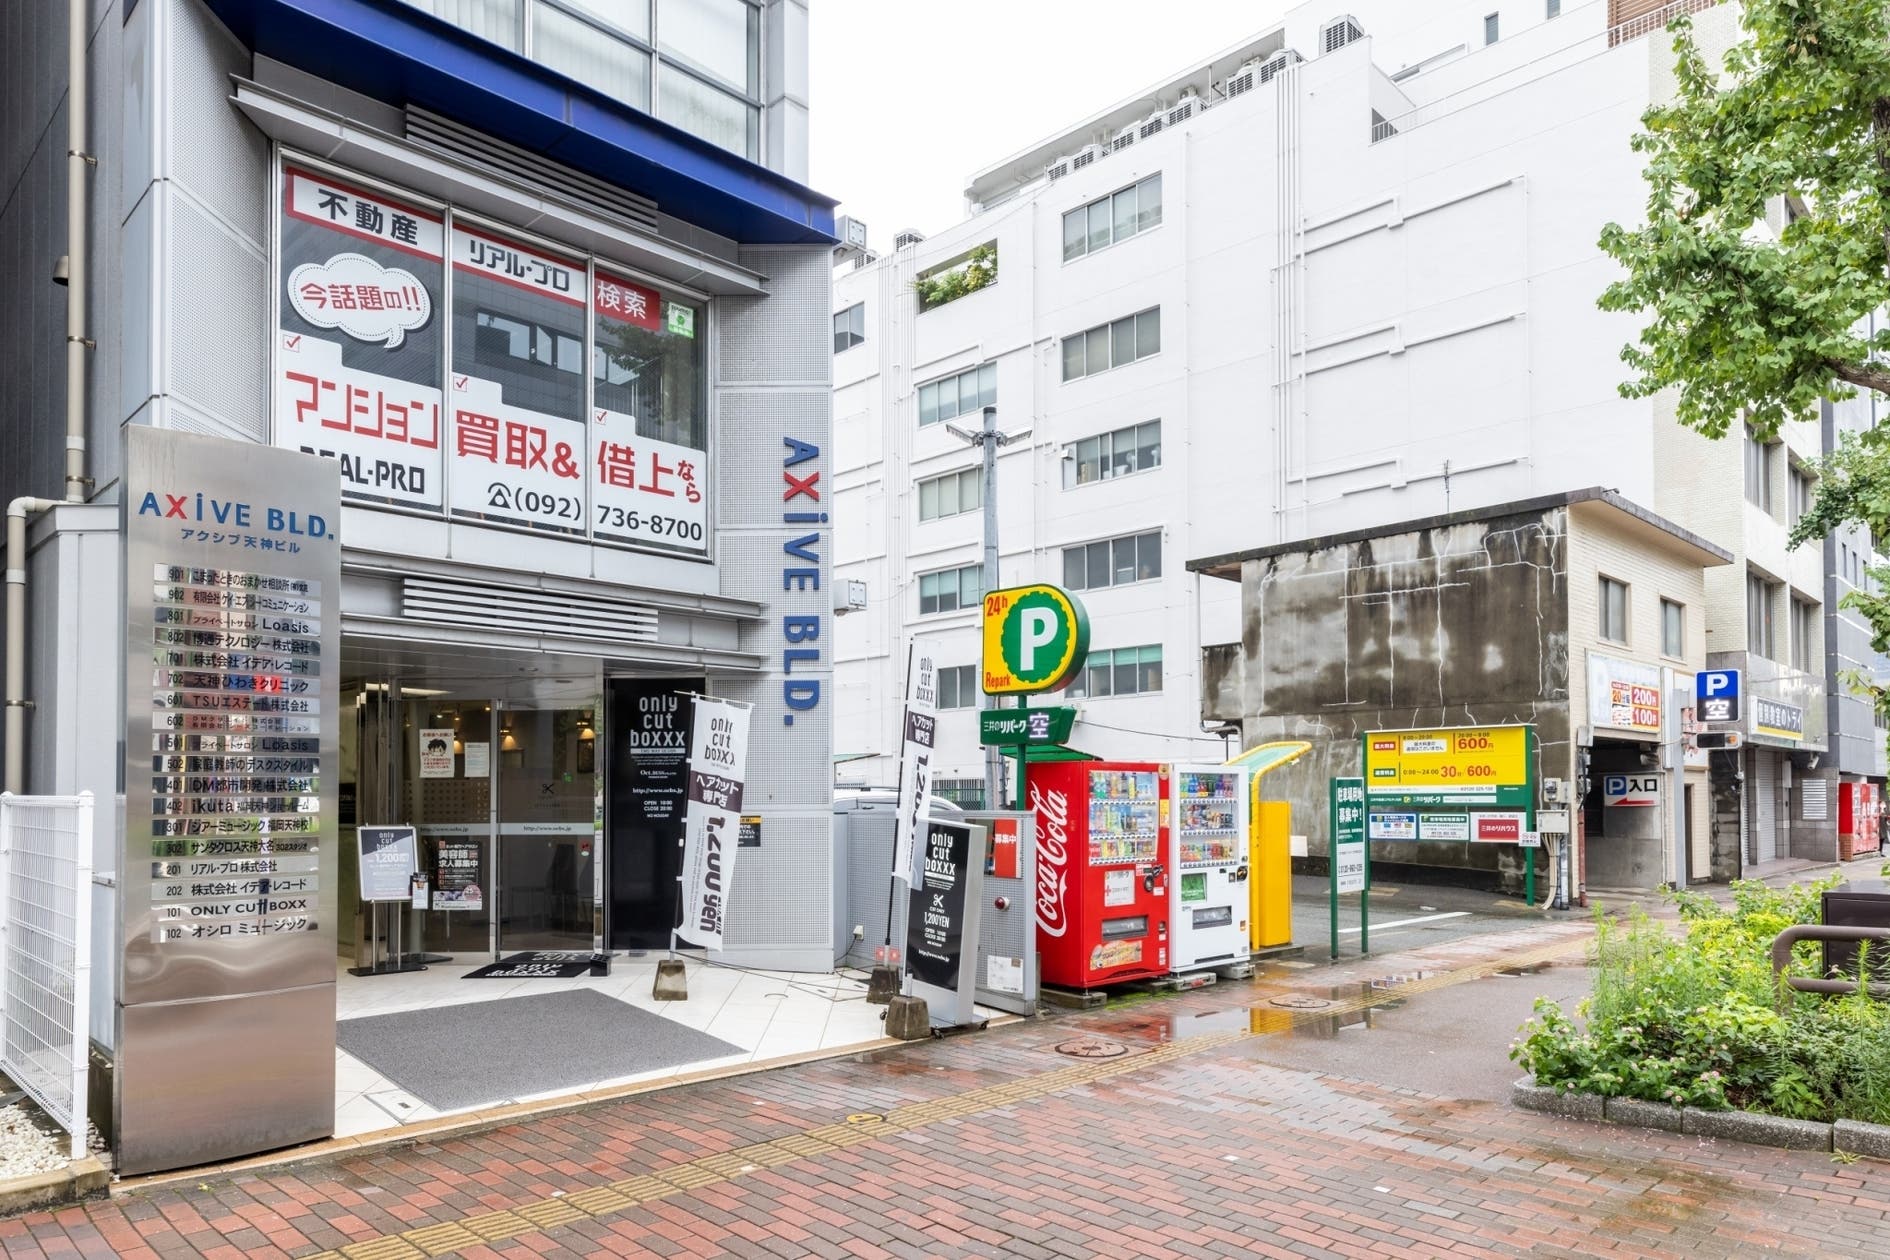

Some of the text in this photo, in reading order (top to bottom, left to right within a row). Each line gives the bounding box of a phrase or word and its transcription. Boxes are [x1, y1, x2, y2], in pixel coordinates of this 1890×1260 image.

[318, 187, 418, 246] 不動産
[597, 281, 646, 320] 検索
[286, 371, 438, 450] マンション
[514, 485, 581, 521] (092)
[267, 508, 334, 540] BLD.
[597, 504, 702, 541] 736-8700
[181, 528, 301, 554] アクシブ天神ビル
[168, 568, 185, 581] 901
[168, 588, 185, 601] 902
[168, 611, 184, 622] 801
[263, 618, 310, 634] Loasis
[168, 631, 184, 643] 802
[1020, 607, 1059, 672] P
[168, 651, 184, 663] 701
[193, 652, 239, 668] 株式会社
[168, 673, 184, 684] 702
[784, 615, 820, 726] BLD.
[986, 672, 1011, 689] Repark
[1706, 673, 1729, 696] P
[167, 694, 184, 706] 601
[639, 694, 678, 712] only
[1705, 699, 1730, 720] 空
[643, 713, 673, 729] cut
[1029, 712, 1050, 739] 空
[194, 741, 259, 751] ライベートサロン
[262, 739, 309, 752] Loasis
[630, 729, 686, 747] boxxx
[712, 733, 731, 749] cut
[167, 759, 184, 769] 502
[696, 774, 739, 795] ヘアカット
[1608, 778, 1658, 794] P 入口
[192, 798, 234, 812] ikuta
[702, 789, 729, 808] 専門店
[931, 833, 954, 848] only
[932, 847, 951, 861] cut
[167, 861, 278, 875] 201 リアル・プロ 株式会社
[925, 857, 956, 875] boxxx
[167, 886, 183, 896] 202
[191, 883, 238, 896] 株式会社
[167, 908, 182, 917] 101
[191, 905, 231, 917] ONLY
[270, 899, 307, 912] BOXX
[167, 919, 307, 939] 102 オシロ ミュージック
